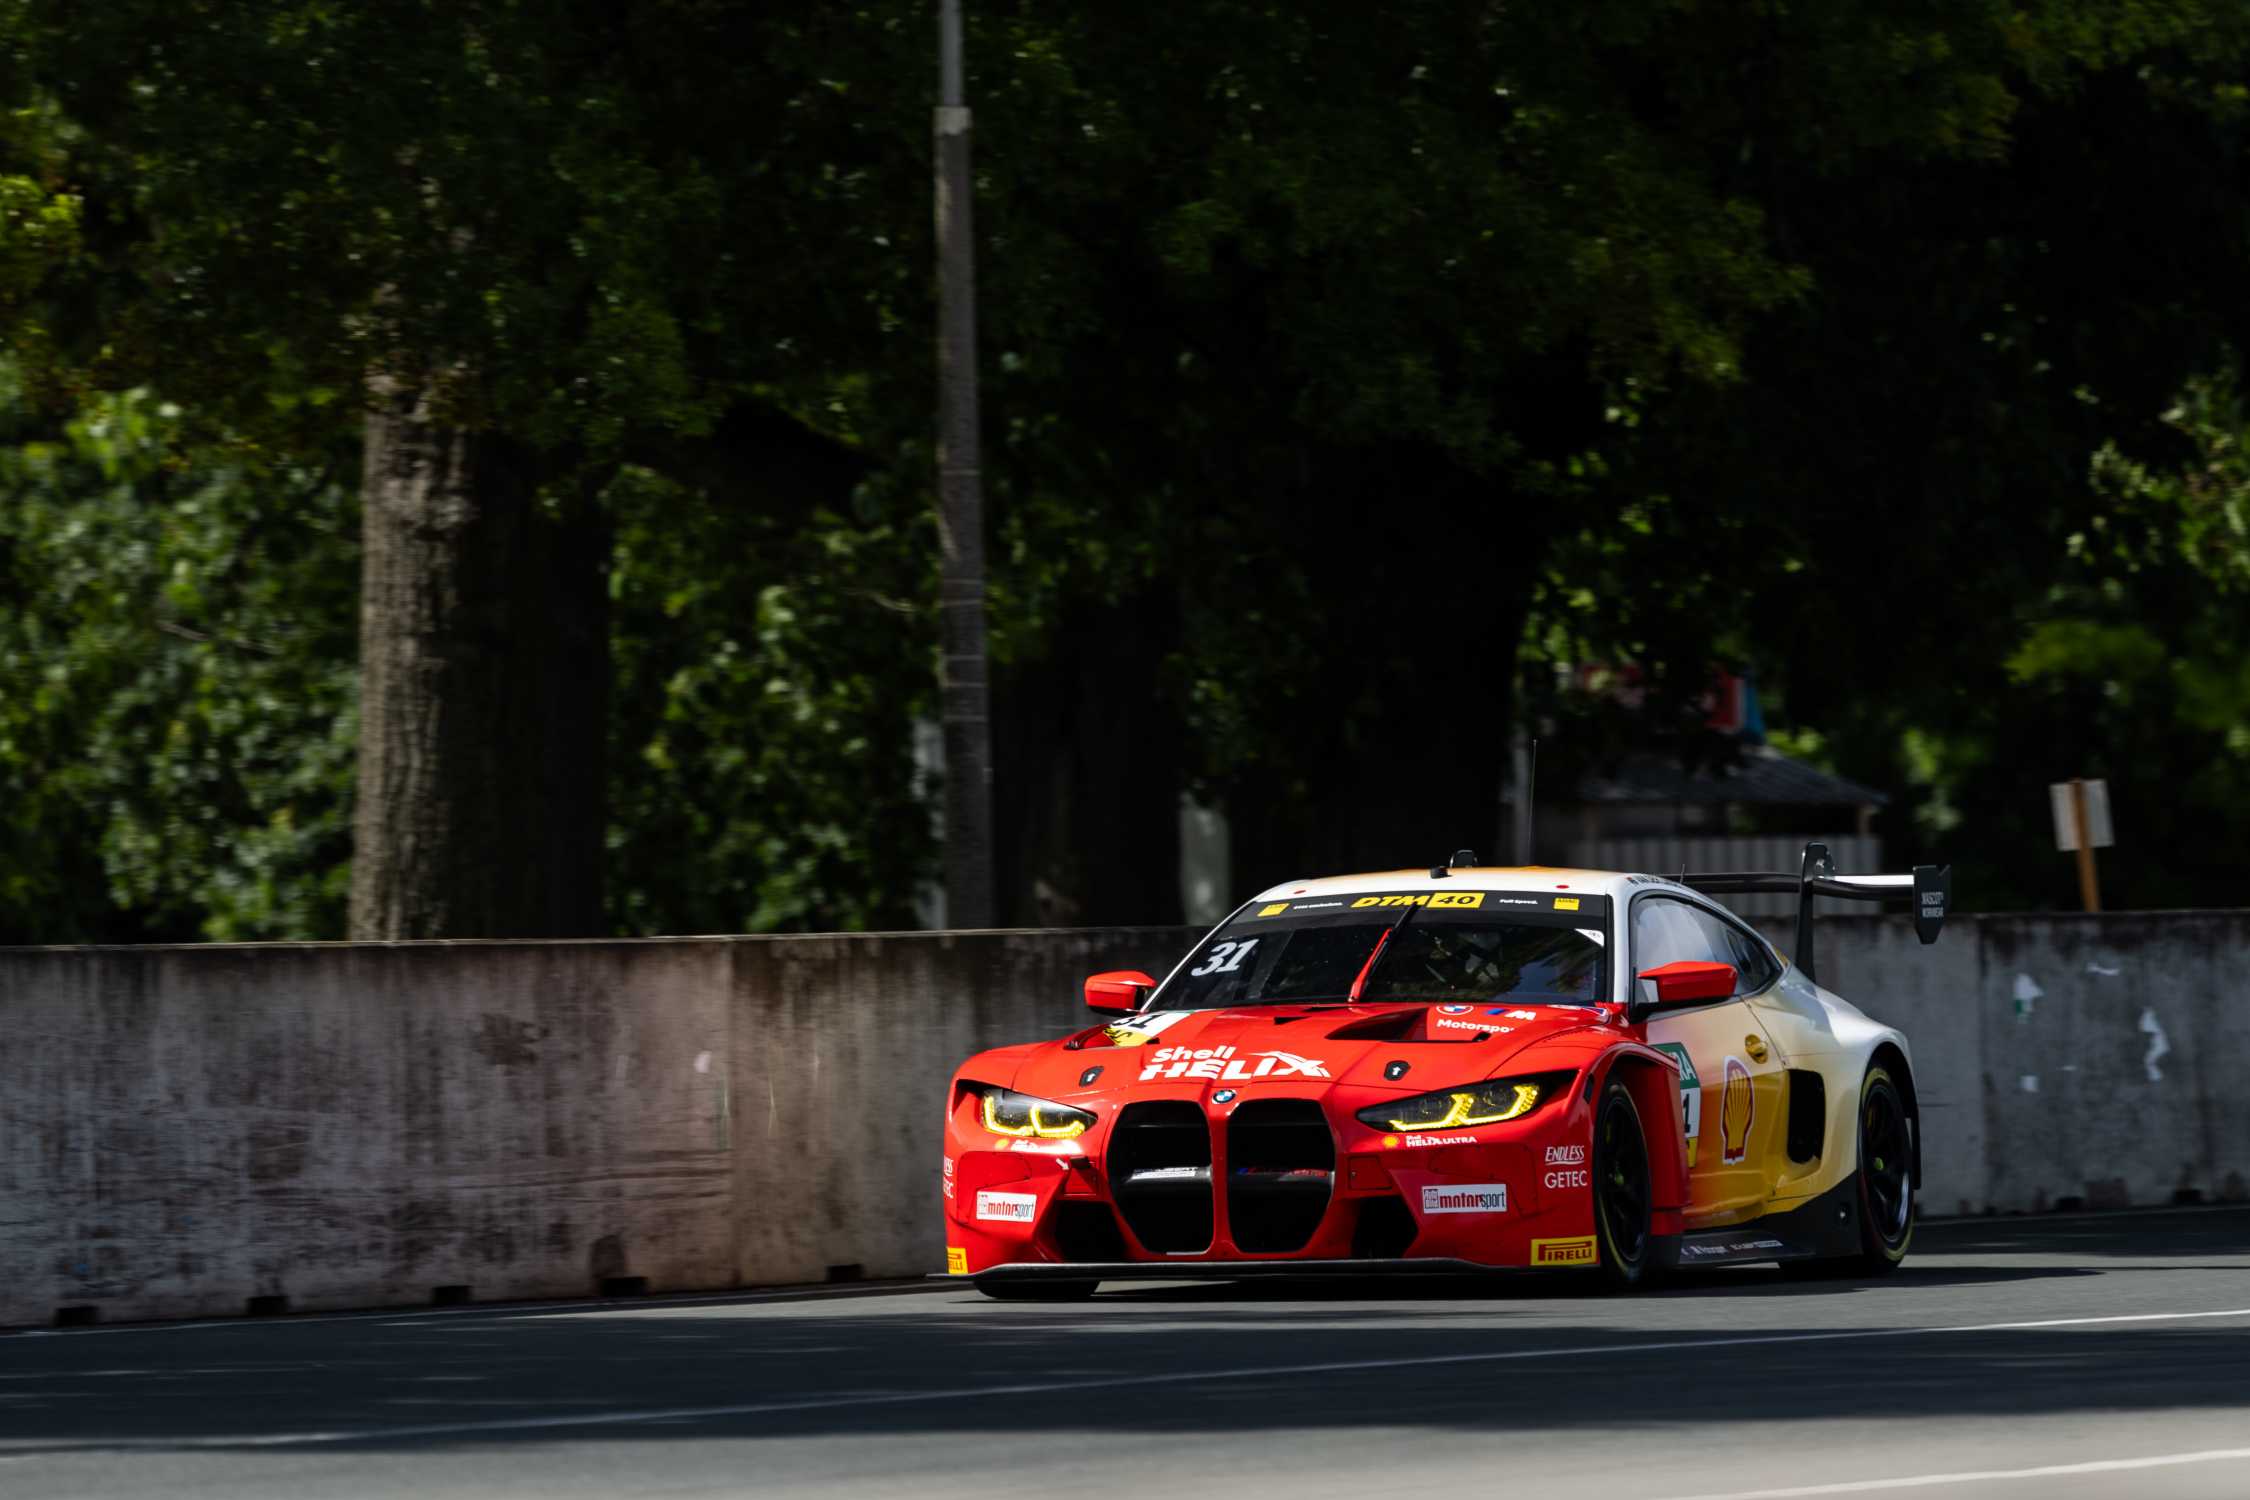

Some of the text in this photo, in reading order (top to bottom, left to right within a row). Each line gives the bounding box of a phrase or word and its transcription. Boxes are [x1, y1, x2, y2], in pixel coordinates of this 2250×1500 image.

[1351, 895, 1430, 908] DTM
[1191, 939, 1260, 976] 31
[1152, 1045, 1236, 1063] Shell
[1139, 1051, 1331, 1081] HELIX
[1545, 1146, 1585, 1165] ENDLESS
[1544, 1170, 1588, 1189] GETEC
[988, 1200, 1034, 1219] motorsport
[1440, 1191, 1505, 1210] motorsport
[1538, 1241, 1593, 1262] PIRELLI
